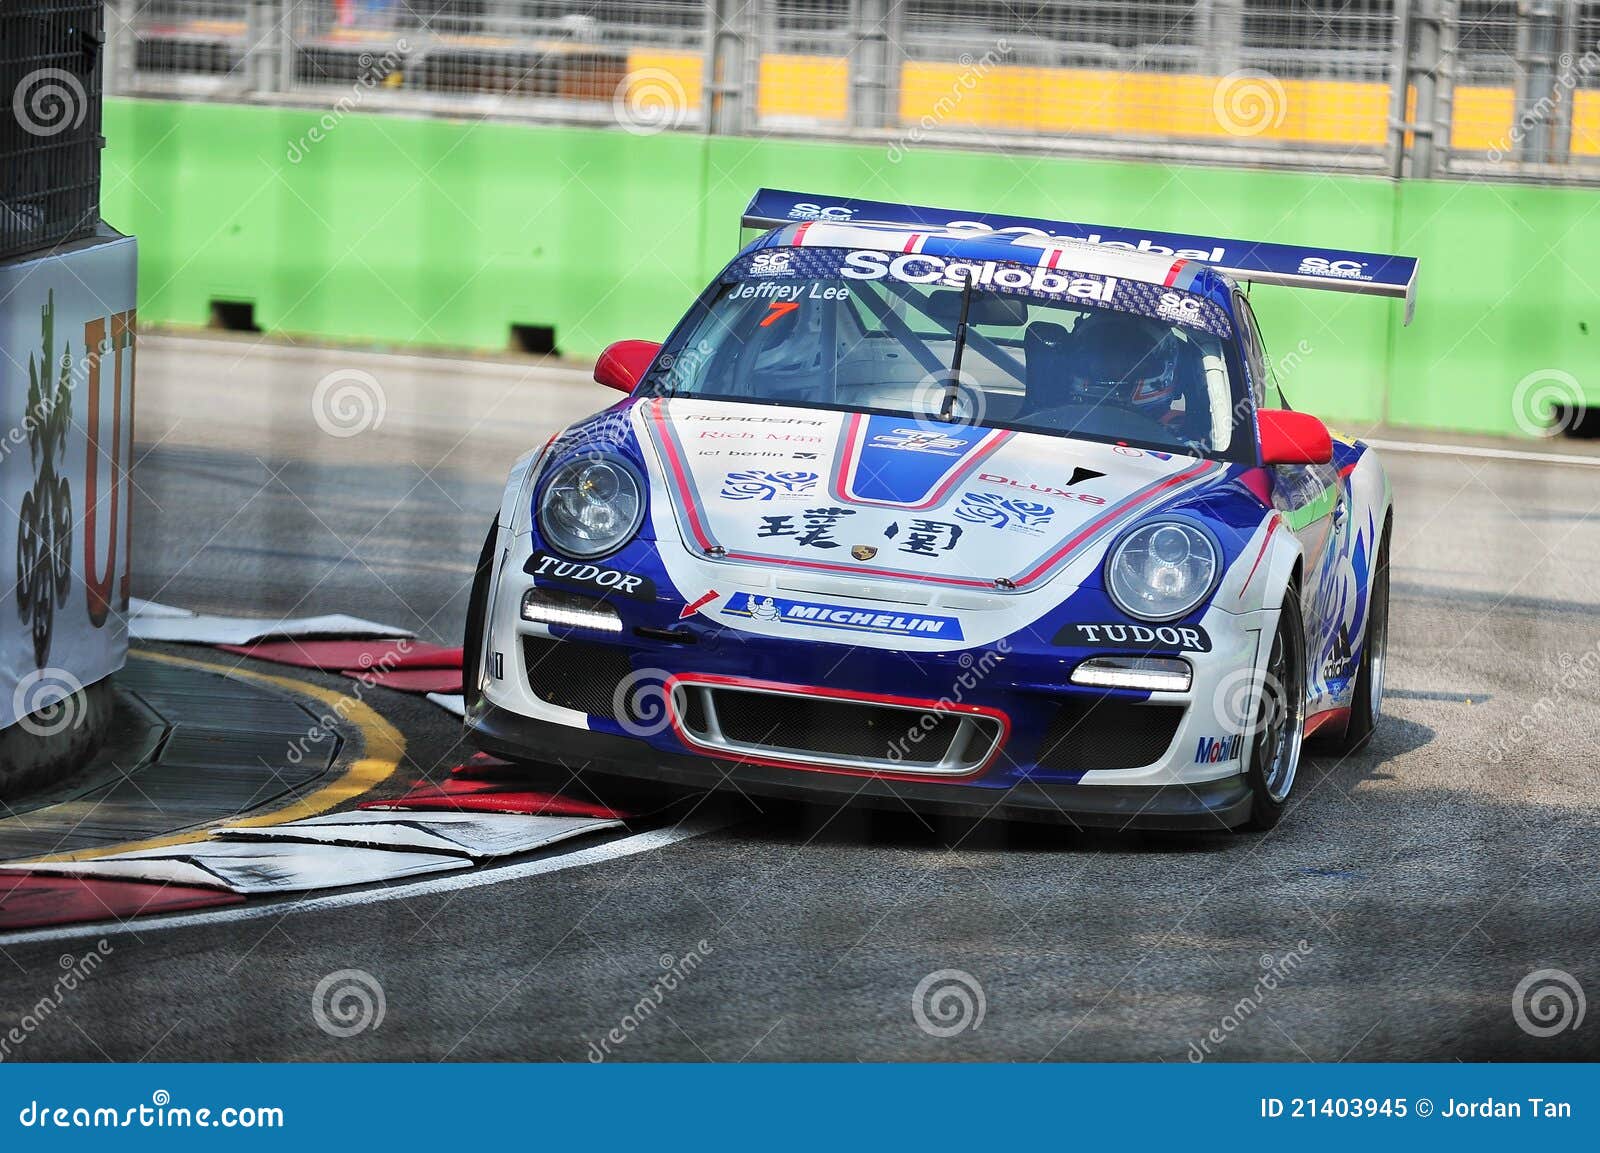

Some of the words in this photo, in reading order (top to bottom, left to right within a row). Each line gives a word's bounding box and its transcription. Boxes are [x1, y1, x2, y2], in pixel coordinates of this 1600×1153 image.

[753, 252, 789, 267] SC
[729, 281, 805, 302] Jeffrey
[809, 283, 849, 300] Lee
[1160, 293, 1201, 312] SC
[760, 301, 800, 328] 7
[699, 431, 755, 440] Rich
[766, 431, 823, 444] Man
[536, 556, 643, 593] TUDOR
[787, 605, 945, 633] MICHELIN
[1077, 624, 1204, 650] TUDOR
